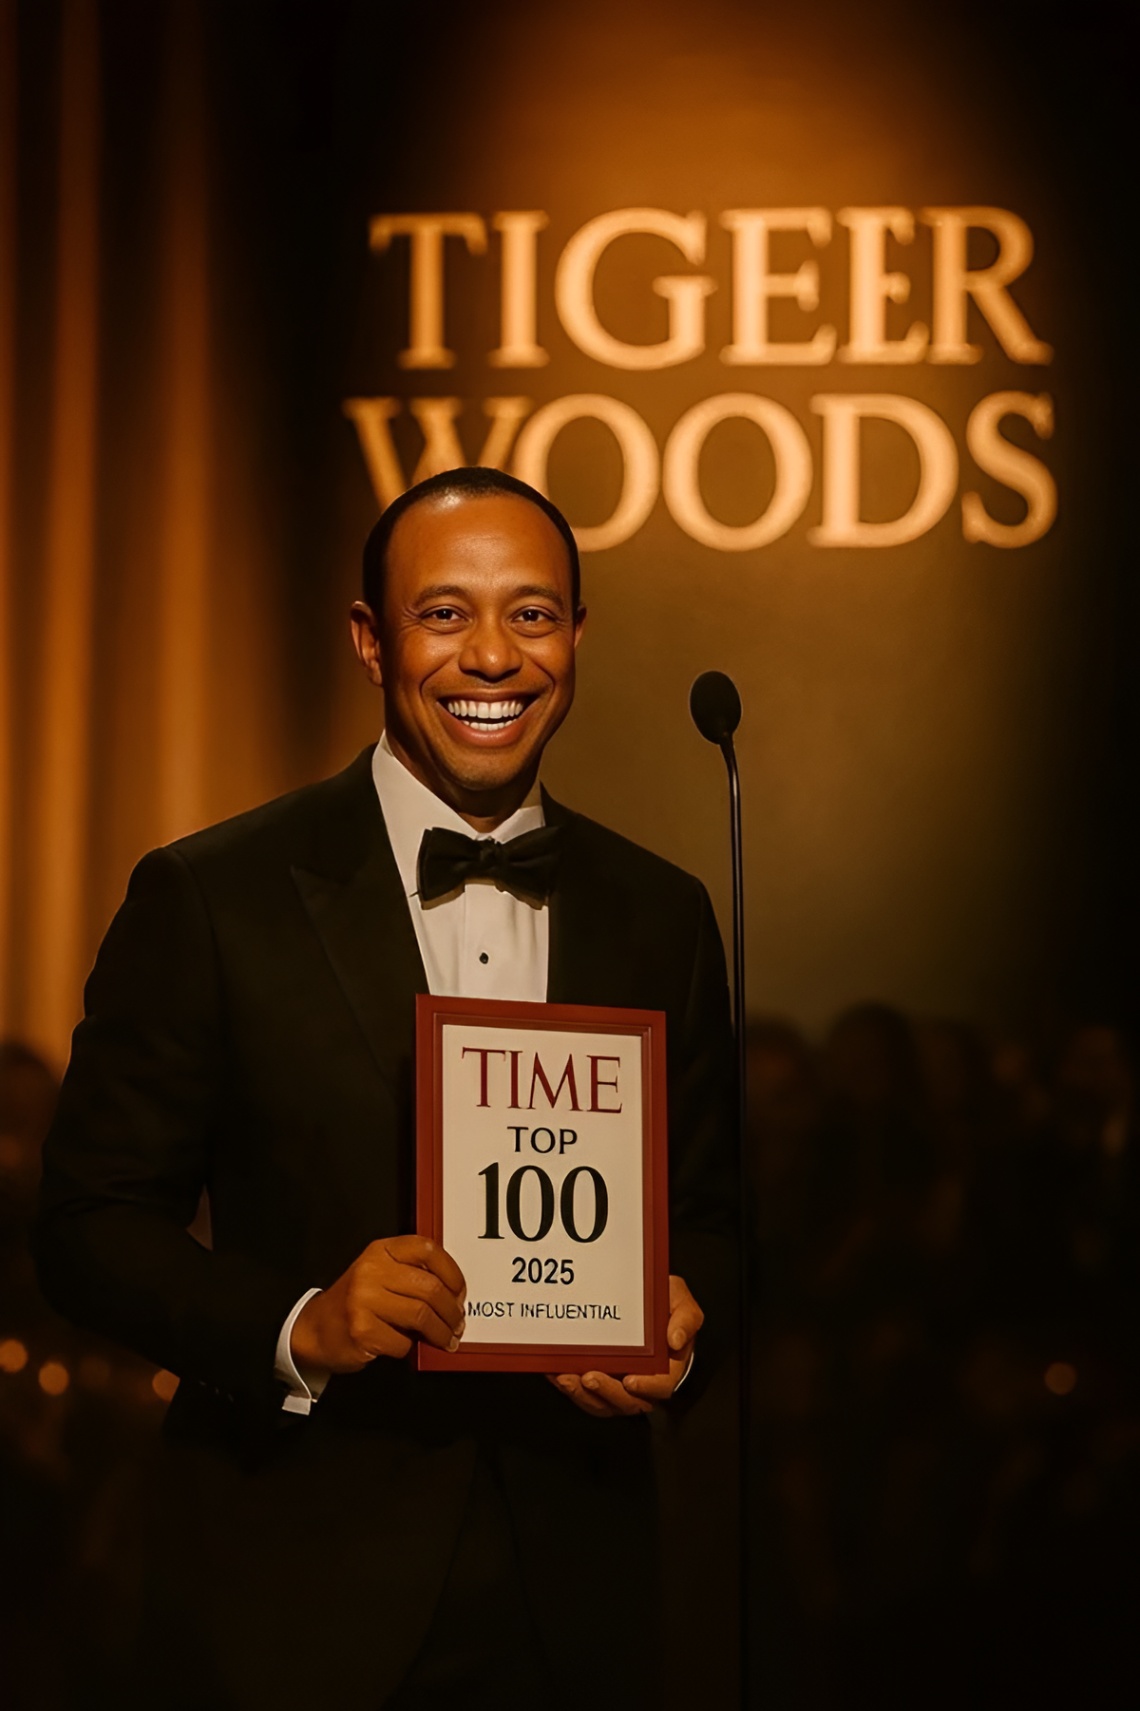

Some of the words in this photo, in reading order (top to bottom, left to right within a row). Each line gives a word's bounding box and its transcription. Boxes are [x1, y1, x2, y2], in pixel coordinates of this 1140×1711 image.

[369, 207, 1053, 370] TIGEER
[343, 391, 1059, 552] WOODS
[461, 1046, 623, 1114] TIME
[507, 1126, 578, 1155] TOP
[477, 1162, 609, 1243] 100
[511, 1257, 575, 1285] 2025
[467, 1302, 515, 1317] MOST
[520, 1303, 621, 1320] INFLUENTIAL
